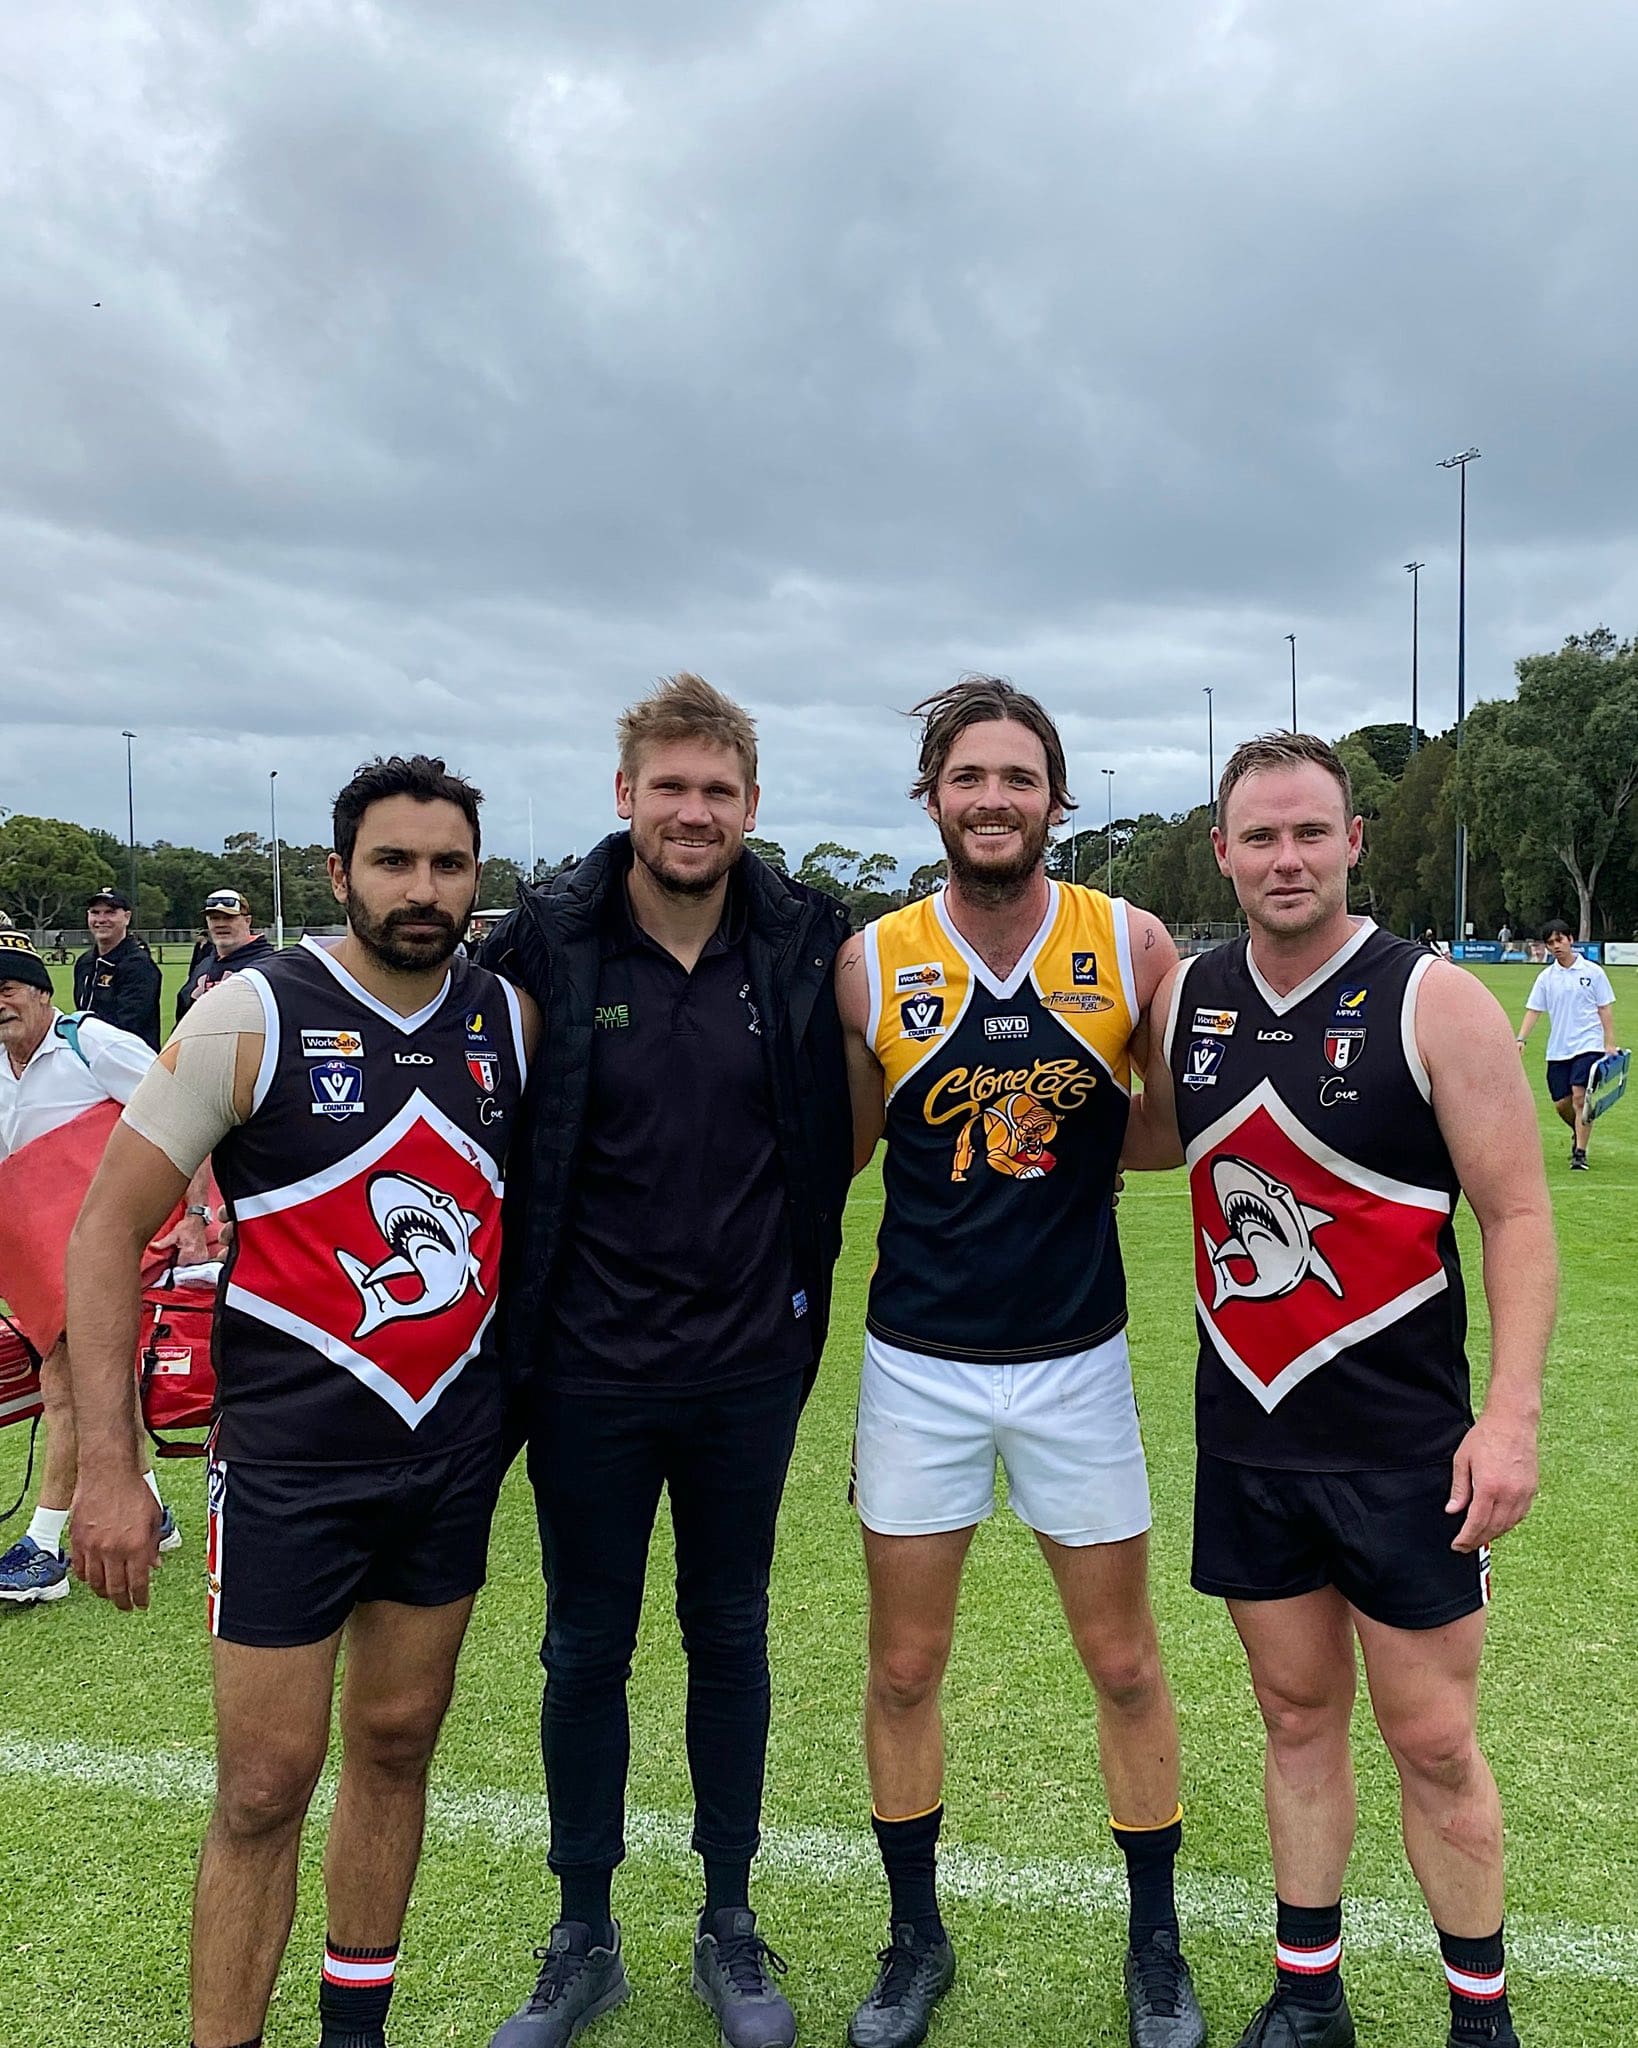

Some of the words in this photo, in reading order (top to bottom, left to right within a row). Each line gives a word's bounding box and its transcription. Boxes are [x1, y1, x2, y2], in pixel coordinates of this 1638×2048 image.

[914, 993, 931, 1001] AFL
[987, 1018, 1026, 1032] SWD
[307, 1037, 357, 1048] WorkSafe
[327, 1062, 346, 1070] AFL
[1320, 1076, 1359, 1106] Cove
[322, 1104, 355, 1112] COUNTRY
[481, 1097, 504, 1125] Cove
